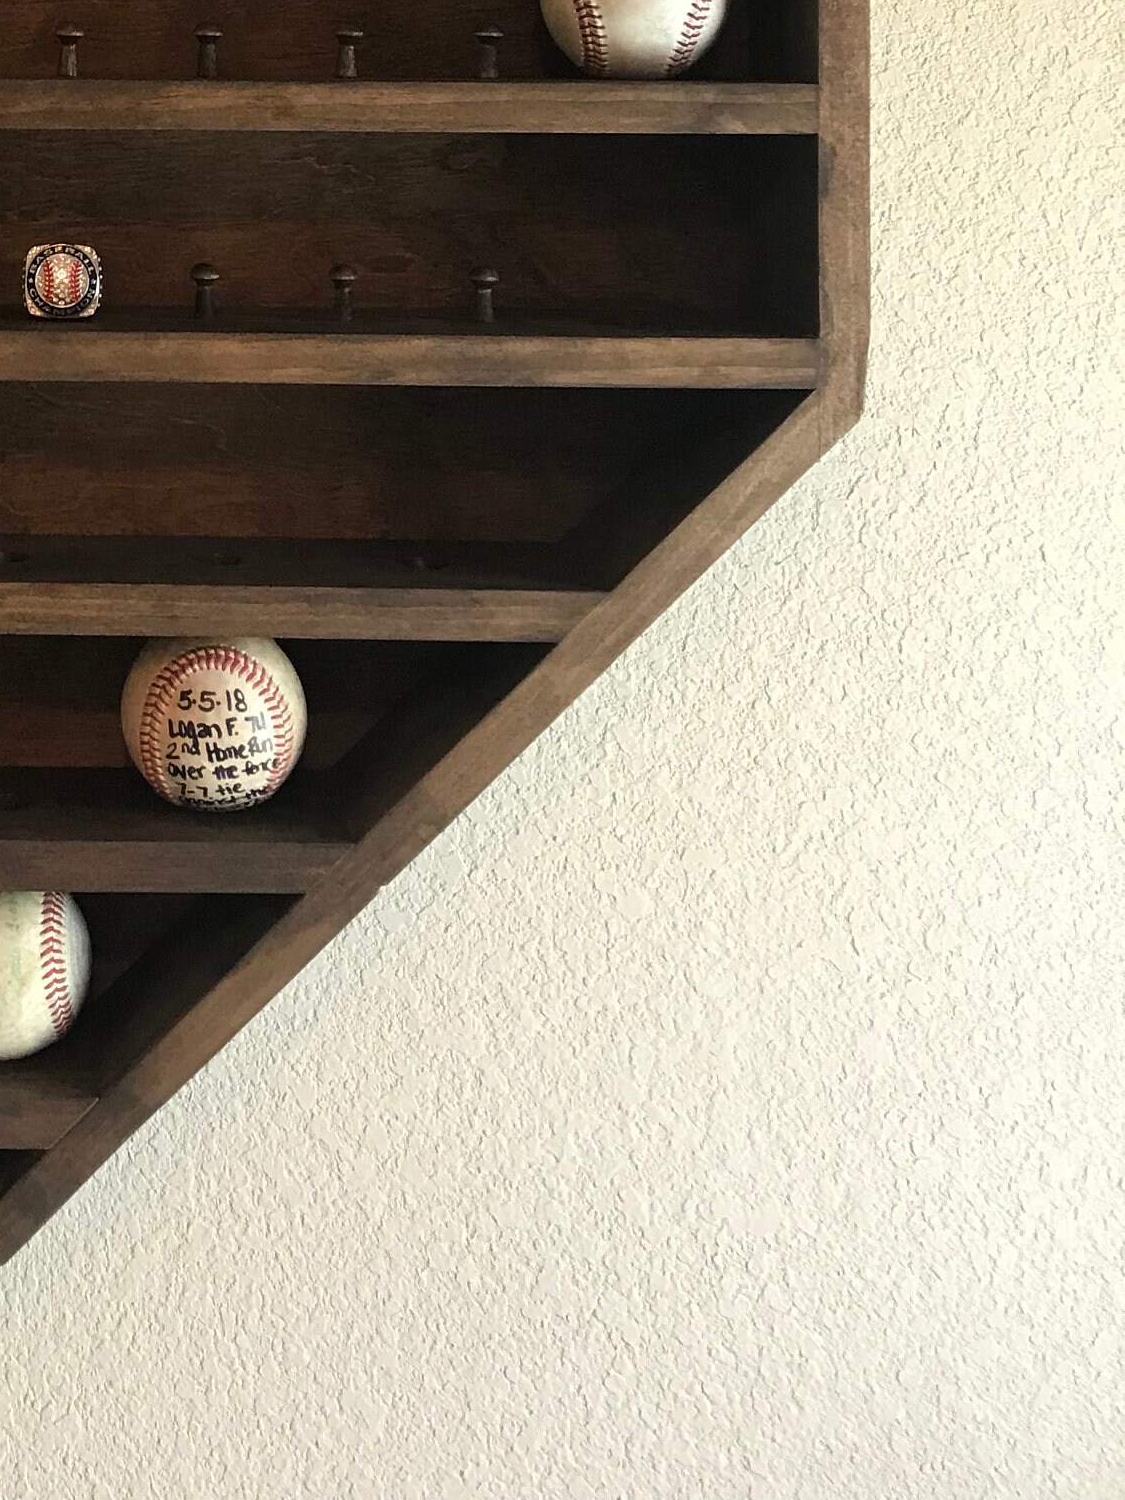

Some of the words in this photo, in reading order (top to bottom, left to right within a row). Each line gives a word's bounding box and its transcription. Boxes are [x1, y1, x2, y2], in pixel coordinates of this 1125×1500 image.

[167, 718, 222, 743] Logan
[166, 742, 201, 760] 2nd
[205, 742, 249, 763] Home
[247, 736, 274, 757] Run
[215, 782, 246, 796] tie
